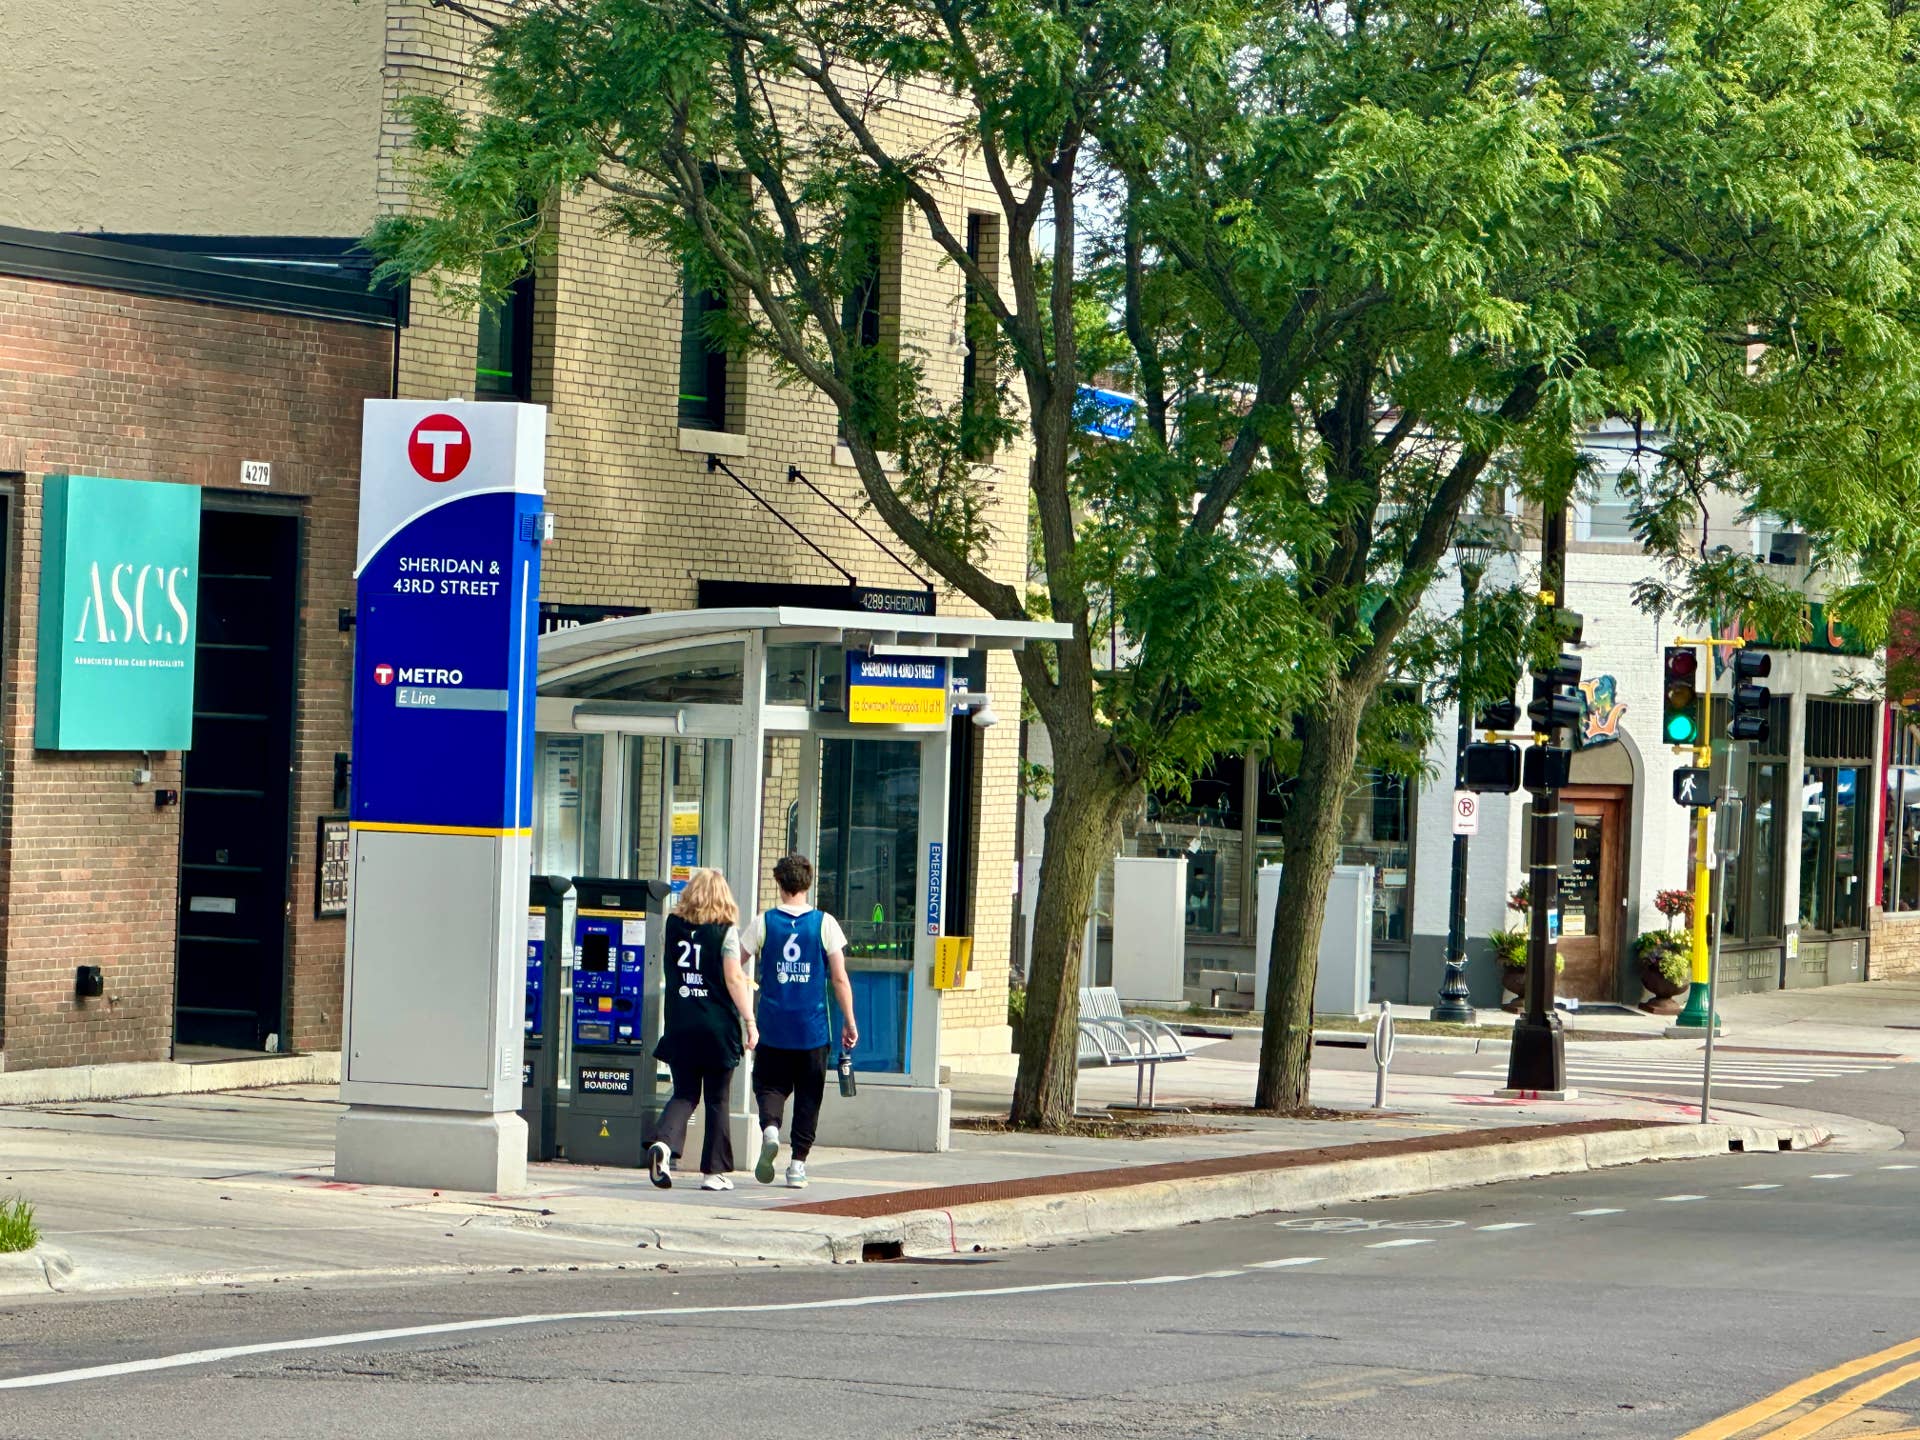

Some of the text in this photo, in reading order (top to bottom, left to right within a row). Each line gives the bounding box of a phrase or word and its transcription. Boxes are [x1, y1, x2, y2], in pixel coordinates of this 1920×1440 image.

[417, 430, 463, 474] T
[245, 464, 269, 482] 4279
[399, 557, 500, 575] SHERIDAN &
[393, 578, 500, 596] 43RD STREET
[74, 561, 189, 646] ASCS
[860, 593, 926, 612] 4289 SHERIDAN
[398, 668, 463, 685] METRO
[861, 662, 892, 677] SHERIDAN
[915, 664, 935, 679] STREET
[399, 689, 436, 705] E Line
[929, 845, 941, 919] EMERGENCY
[676, 940, 702, 970] 21
[783, 933, 801, 962] 6
[776, 962, 811, 974] CARLETON
[789, 973, 811, 983] AT&T
[582, 1070, 630, 1081] PAY BEFORE
[584, 1081, 628, 1091] BOARDING
